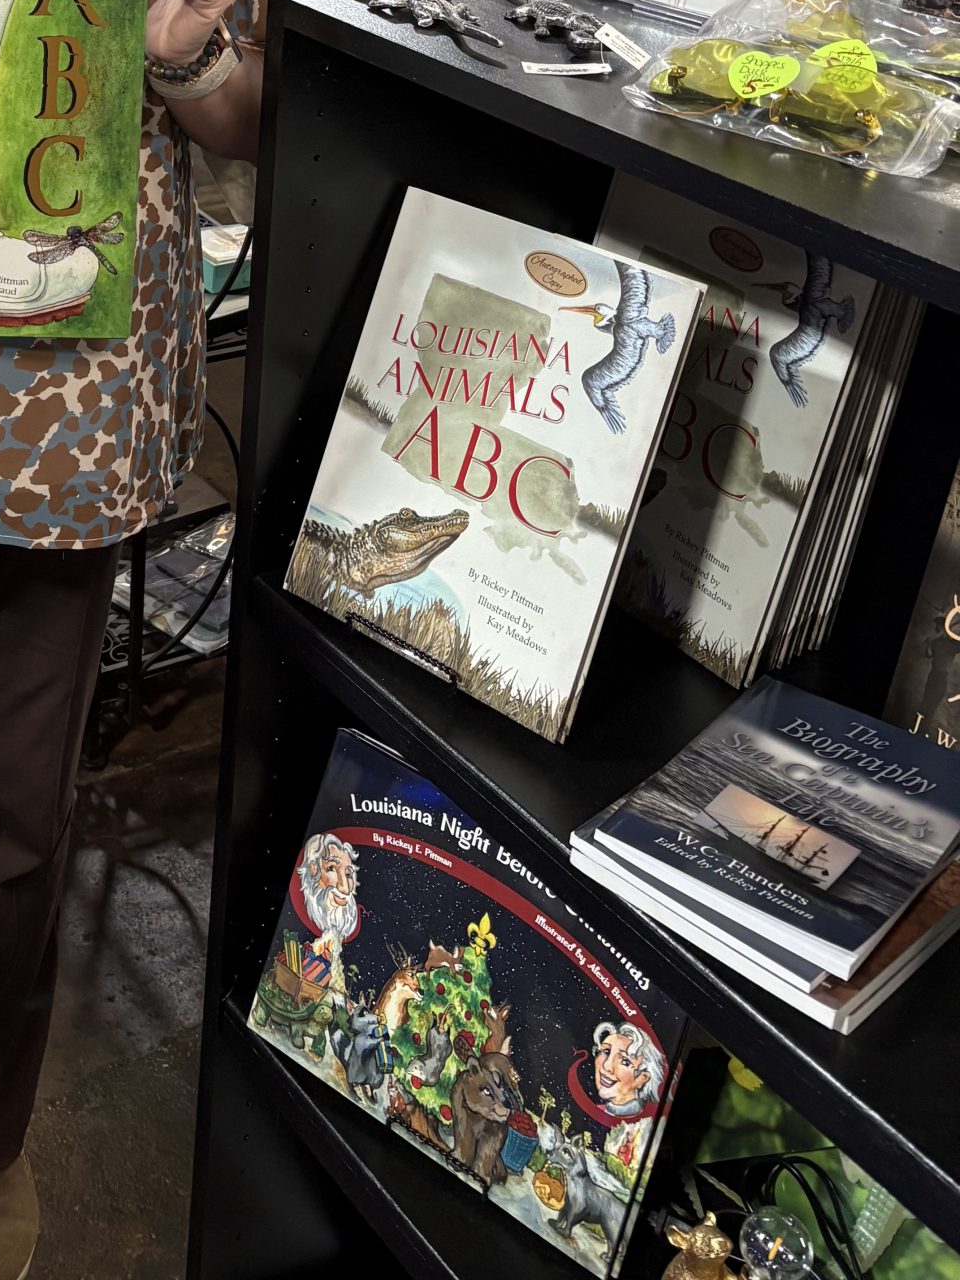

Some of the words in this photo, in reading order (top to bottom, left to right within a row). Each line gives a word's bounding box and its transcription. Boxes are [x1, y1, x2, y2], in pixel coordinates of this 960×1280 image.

[530, 256, 583, 286] Autographed
[542, 274, 563, 291] Copy
[391, 313, 572, 375] LOUISIANA
[377, 356, 570, 424] ANIMALS
[392, 405, 572, 538] ABC
[672, 549, 710, 581] Illustrated
[710, 574, 721, 589] by
[675, 530, 699, 554] Rickey
[700, 547, 730, 573] Pittman
[468, 567, 480, 582] By
[480, 574, 510, 598] Rickey
[510, 589, 545, 615] Pittman
[695, 580, 733, 611] Meadows
[477, 594, 522, 625] Illustrated
[522, 618, 534, 634] by
[486, 615, 505, 634] Kay
[505, 625, 548, 656] Meadows
[776, 717, 937, 795] Biography
[843, 722, 889, 749] The
[722, 732, 776, 766] Sea
[784, 762, 933, 840] Captain's
[820, 763, 850, 777] of
[350, 793, 433, 827] Louisiana
[440, 812, 491, 854] Night
[775, 789, 841, 827] Life
[373, 833, 385, 847] By
[386, 835, 414, 854] Rickey
[415, 843, 423, 855] E.
[424, 847, 453, 869] Pittman
[676, 831, 720, 862] W.C.
[727, 858, 810, 907] Flanders
[654, 837, 698, 861] Edited
[697, 858, 713, 869] by
[714, 867, 757, 892] Rickey
[758, 889, 816, 920] Pittman
[534, 914, 577, 952] Illustrated
[574, 948, 587, 966] by
[587, 963, 611, 988] Alexis
[610, 986, 638, 1017] Braud
